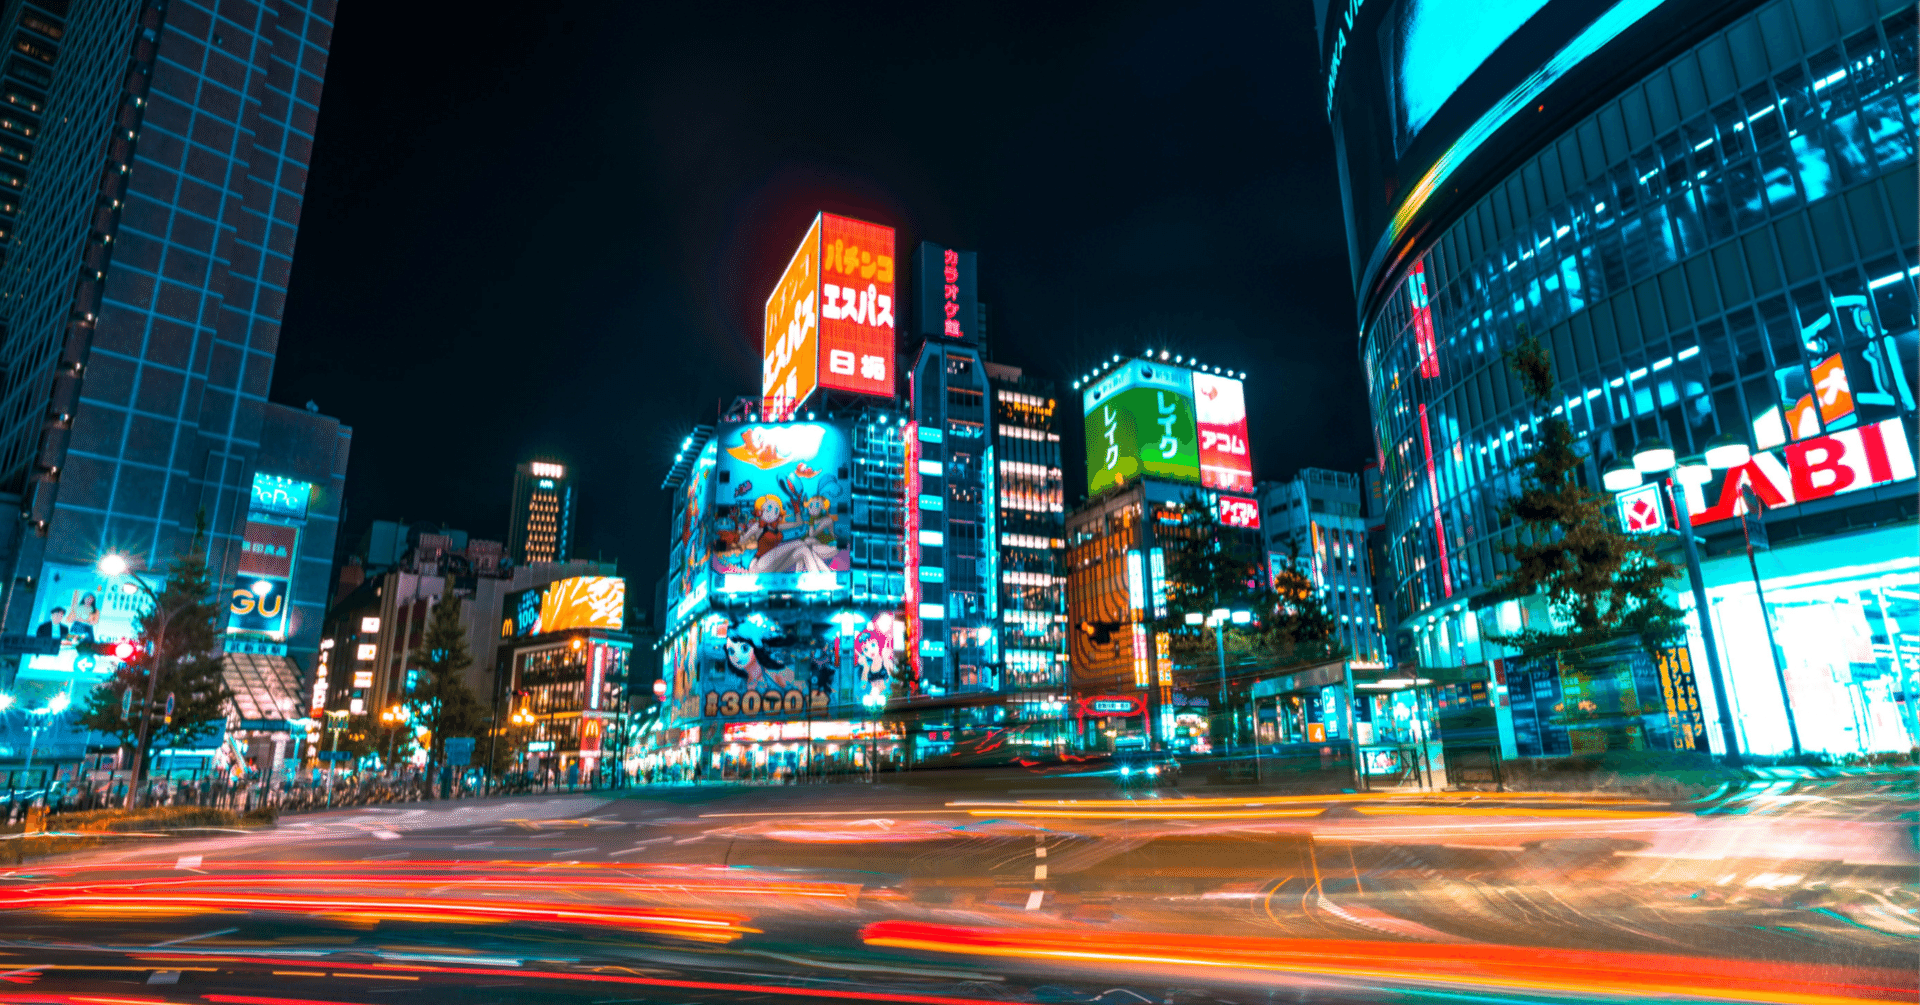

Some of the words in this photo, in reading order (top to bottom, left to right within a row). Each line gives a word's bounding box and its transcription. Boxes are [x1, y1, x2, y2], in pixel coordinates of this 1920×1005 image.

[825, 238, 894, 283] パチンコ
[822, 283, 894, 328] エスパス
[1104, 405, 1119, 470] レイク
[1157, 391, 1178, 459] レイク
[1202, 430, 1246, 456] アコム
[230, 588, 282, 617] GU
